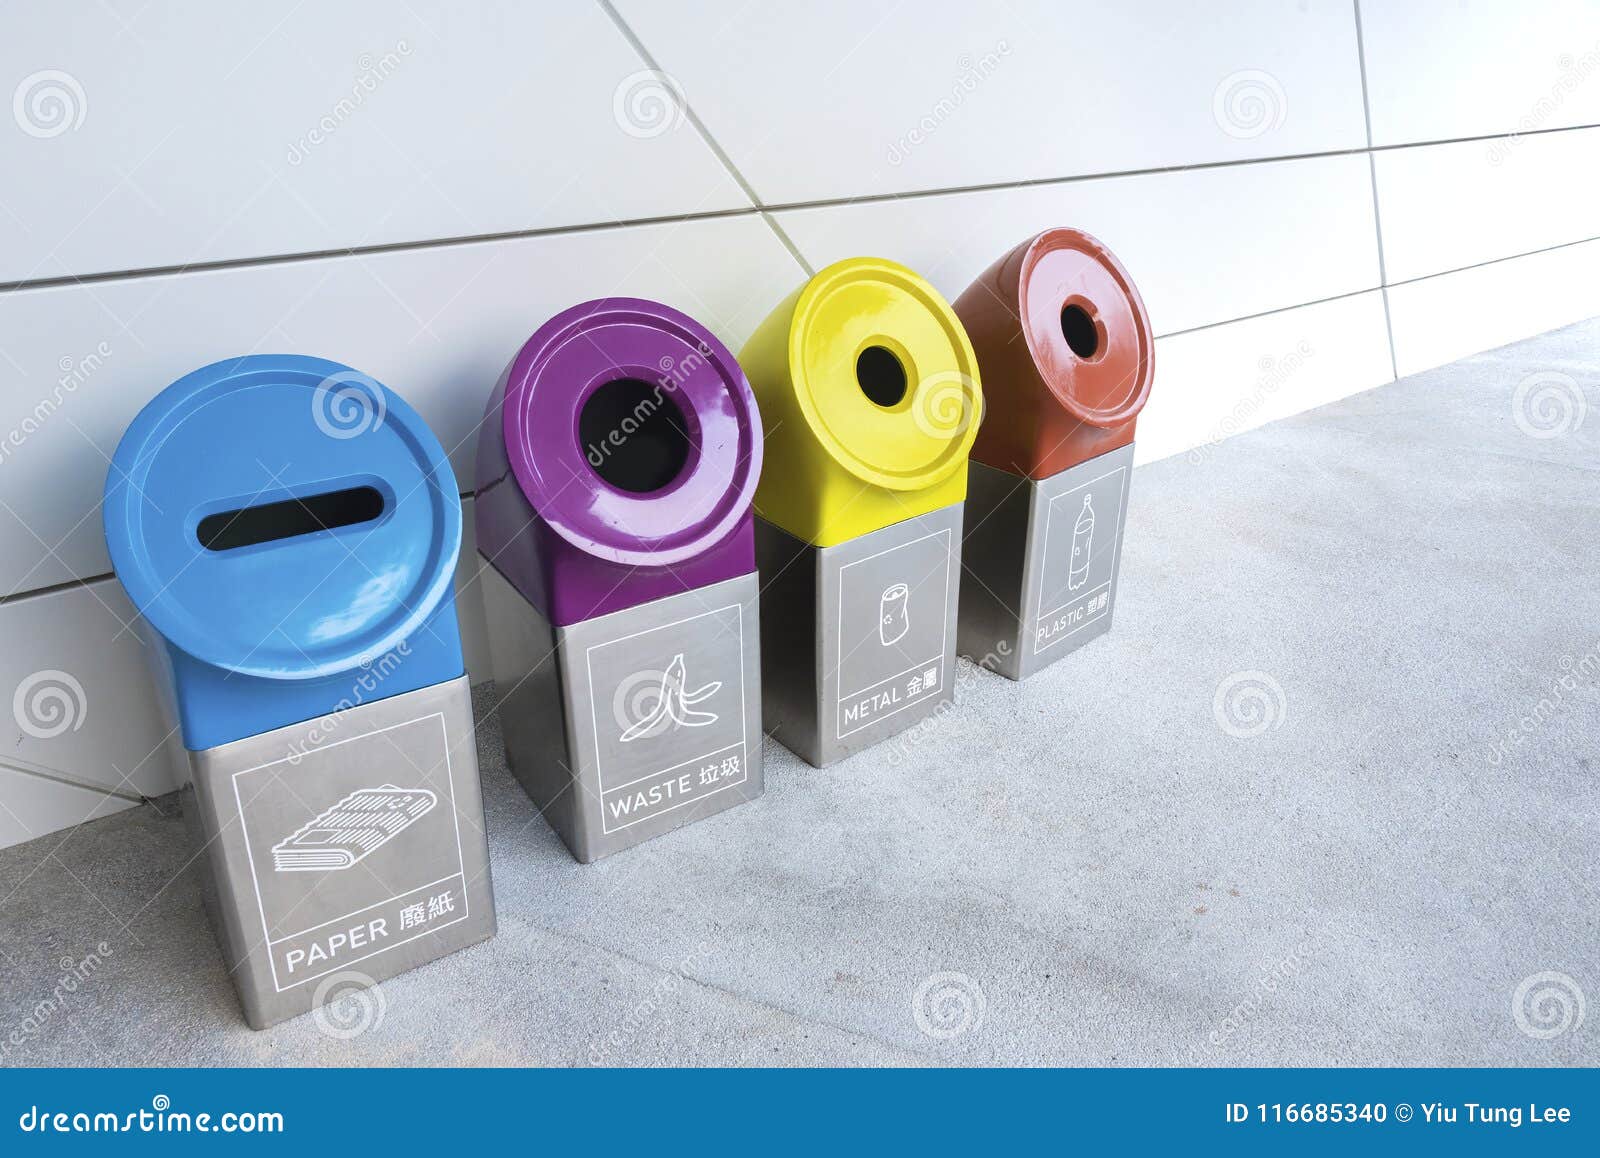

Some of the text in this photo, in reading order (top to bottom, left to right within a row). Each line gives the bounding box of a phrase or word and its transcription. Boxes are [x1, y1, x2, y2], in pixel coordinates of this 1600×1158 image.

[1037, 606, 1084, 643] PLASTIC
[844, 687, 902, 726] METAL
[609, 755, 741, 819] WASTE 垃圾
[286, 890, 455, 973] PAPER 廢紙
